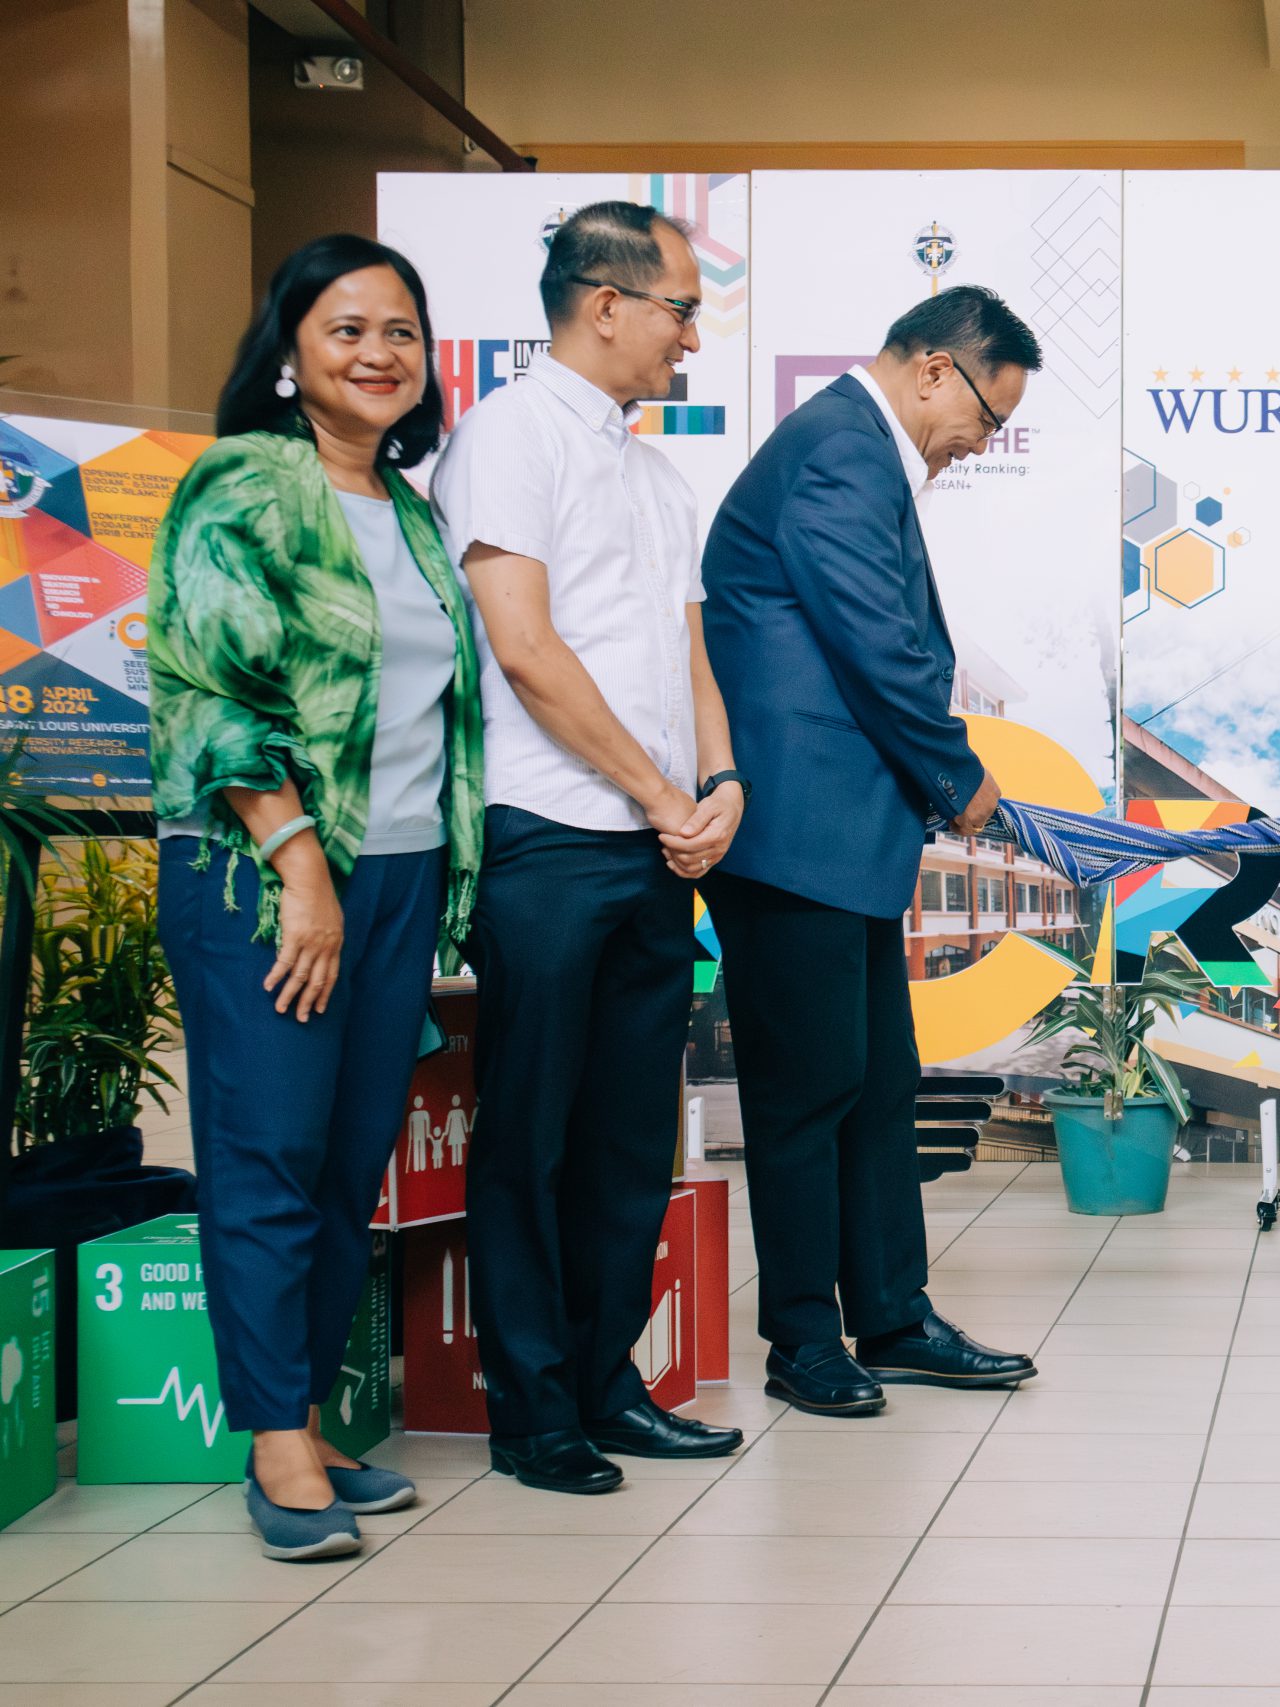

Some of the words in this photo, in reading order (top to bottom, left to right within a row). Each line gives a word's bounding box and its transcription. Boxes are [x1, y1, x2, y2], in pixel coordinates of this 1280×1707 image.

[439, 340, 509, 432] HE
[988, 427, 1030, 454] HE
[974, 463, 1031, 476] Ranking:
[934, 479, 973, 490] SEAN+
[123, 530, 158, 541] CENTE
[42, 686, 100, 702] APRIL
[41, 699, 90, 715] 2024
[39, 720, 80, 732] LOUIS
[95, 1262, 123, 1312] 3
[140, 1263, 190, 1282] GOOD
[140, 1291, 177, 1311] AND
